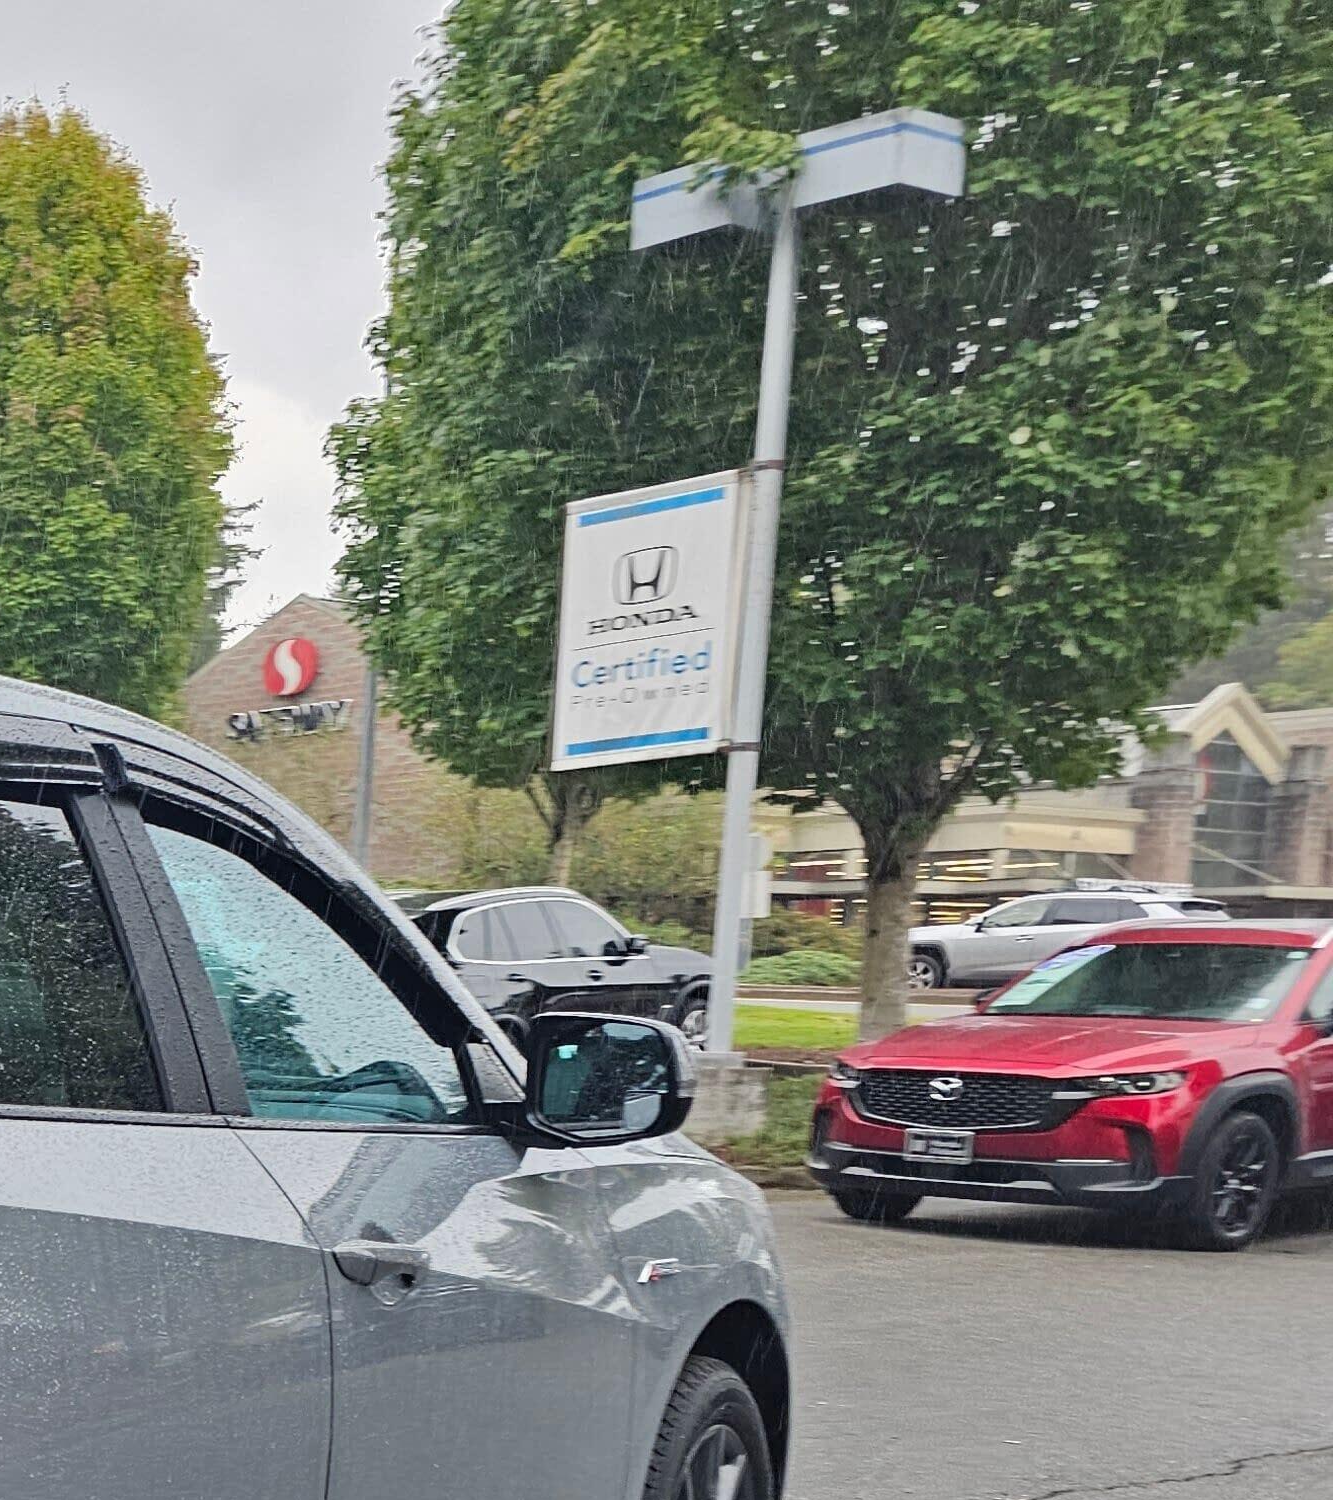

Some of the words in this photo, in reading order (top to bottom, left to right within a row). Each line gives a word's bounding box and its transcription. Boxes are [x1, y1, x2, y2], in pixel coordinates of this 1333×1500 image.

[587, 604, 700, 636] HONDA
[571, 639, 713, 688] Certified
[568, 680, 710, 711] Pre-Owned
